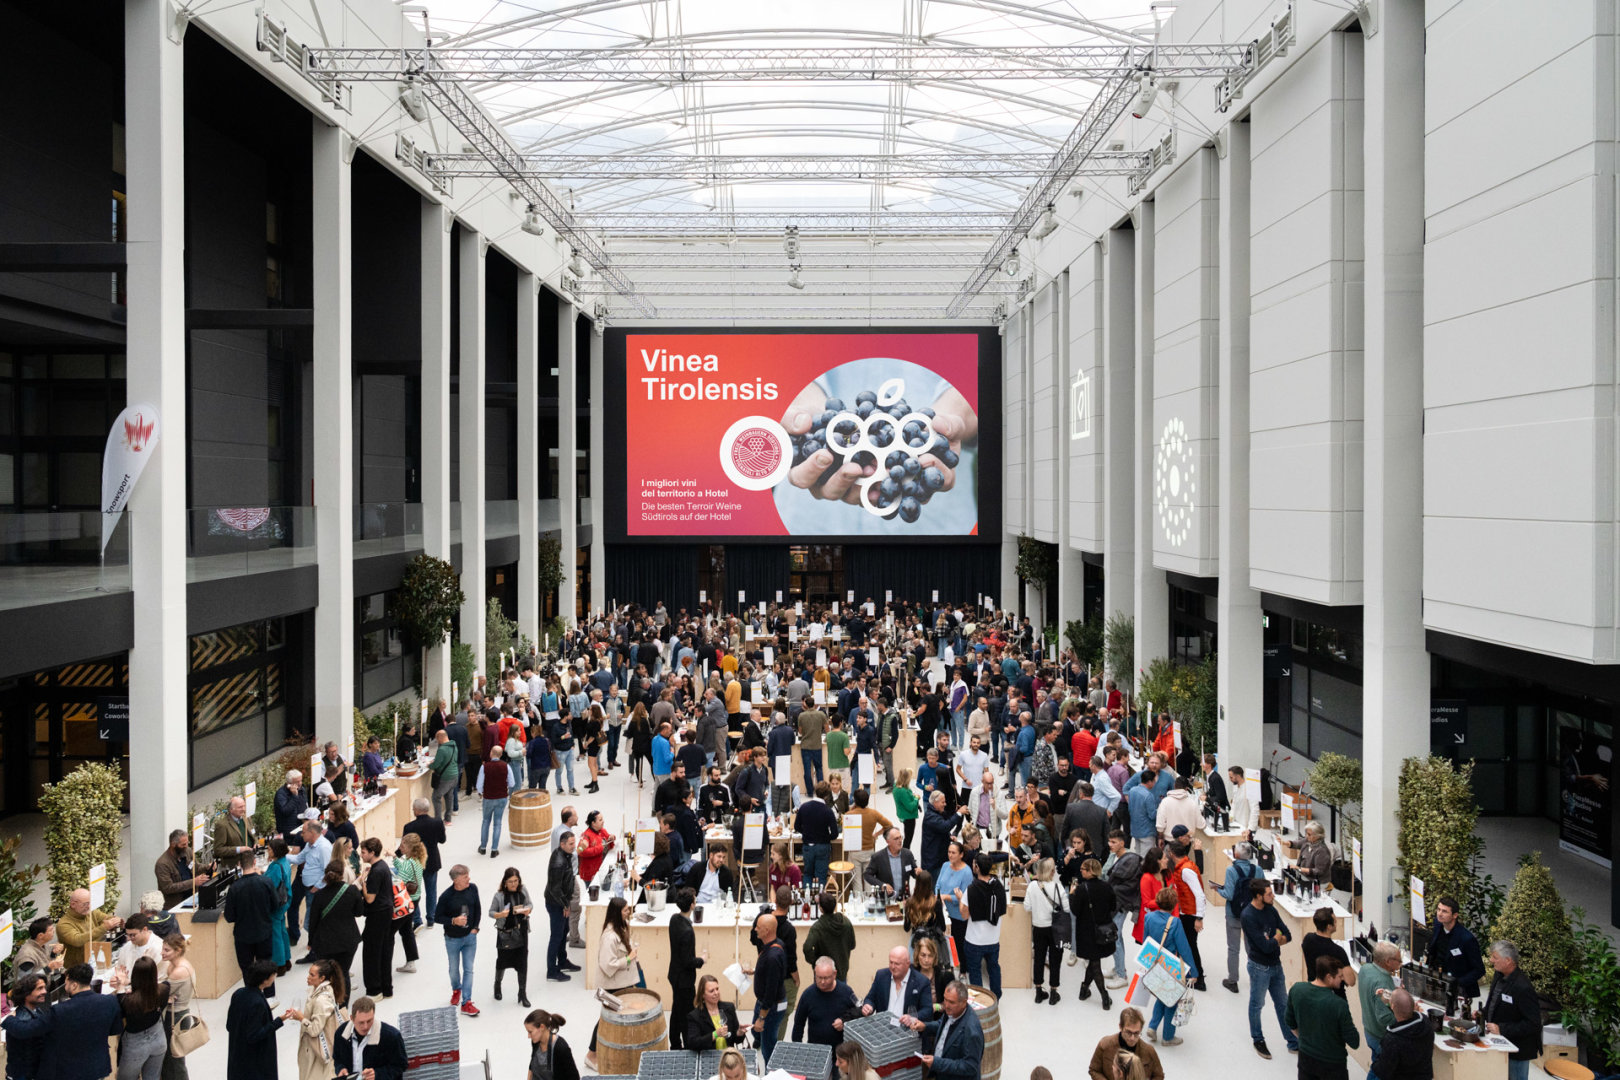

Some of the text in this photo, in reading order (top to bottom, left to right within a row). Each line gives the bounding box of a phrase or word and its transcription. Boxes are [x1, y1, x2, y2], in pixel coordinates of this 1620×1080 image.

[641, 349, 719, 372] Vinea
[641, 377, 779, 401] Tirolensis
[641, 479, 697, 489] I migliori vini
[106, 474, 131, 516] Snowsport
[641, 489, 655, 498] del
[657, 489, 696, 498] territorio
[705, 489, 729, 498] Hotel
[641, 502, 742, 511] Die besten Terroir Weine
[641, 512, 732, 521] Südtirols auf der Hotel
